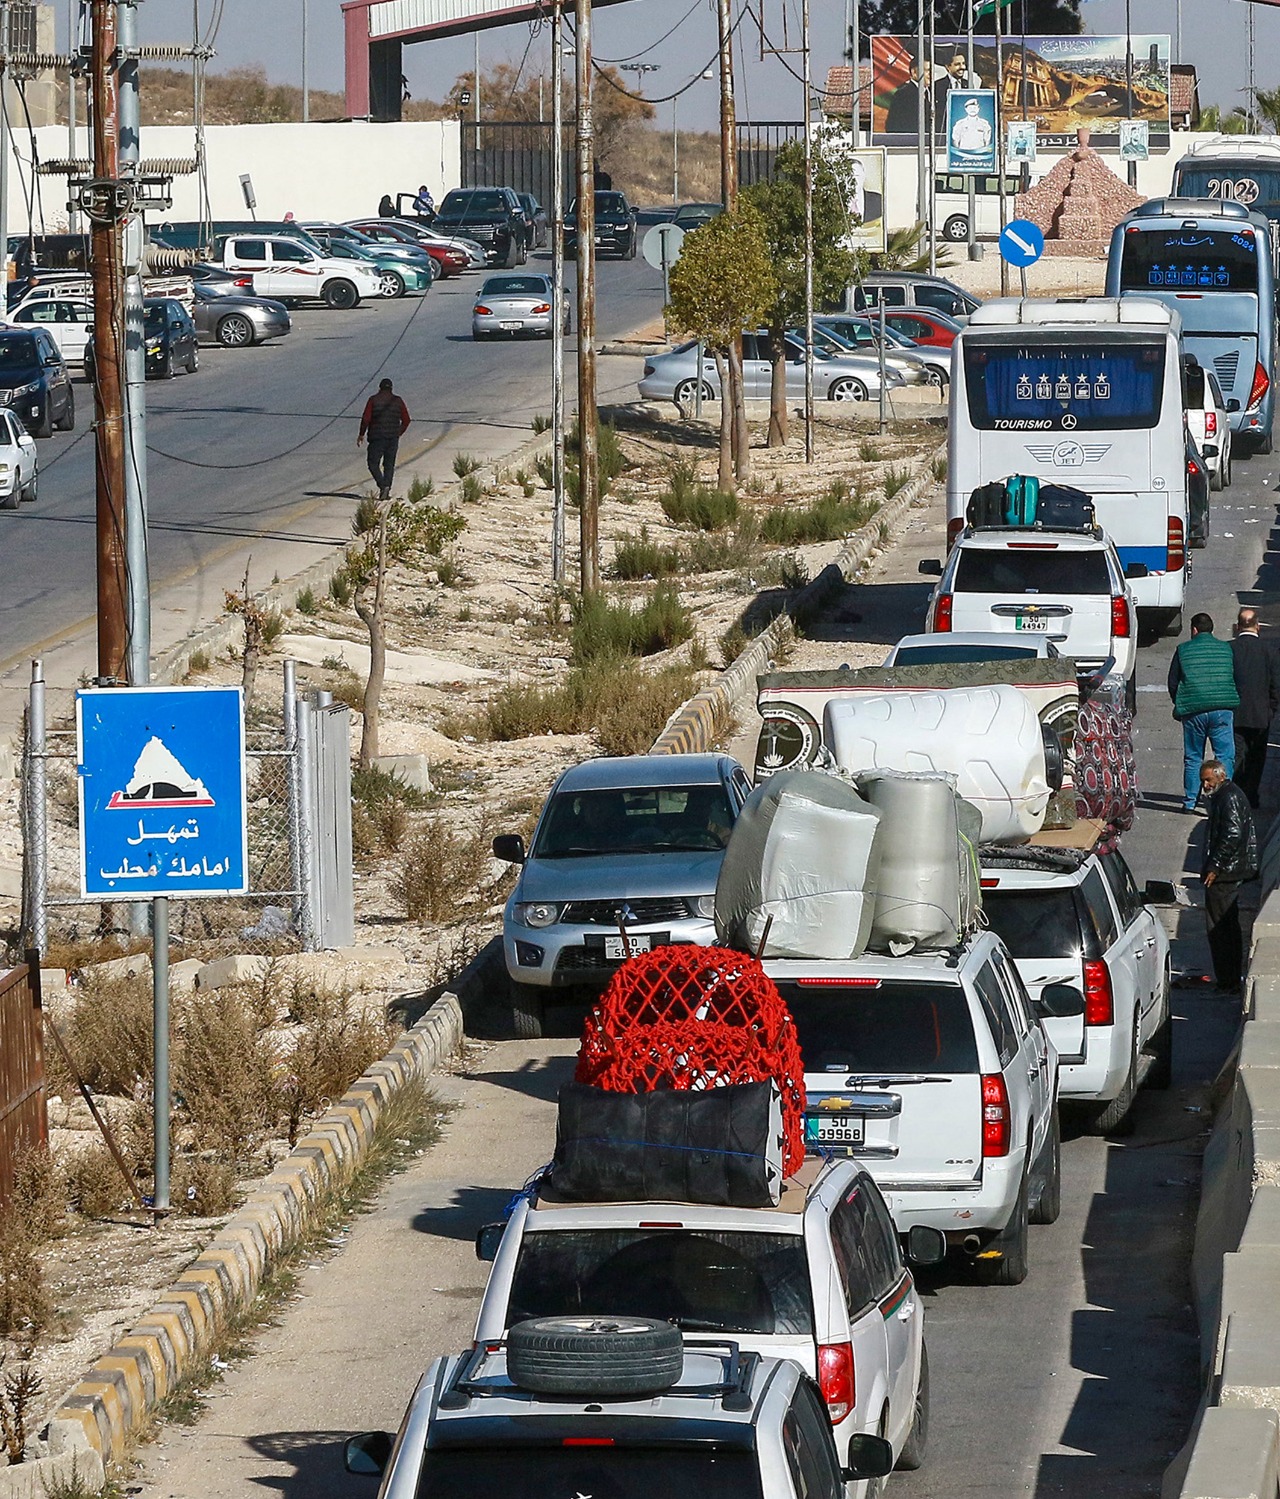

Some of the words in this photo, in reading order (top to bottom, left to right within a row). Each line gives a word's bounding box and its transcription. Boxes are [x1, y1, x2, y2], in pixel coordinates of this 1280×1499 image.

[1207, 178, 1258, 201] 2024
[1231, 234, 1255, 252] 2024
[994, 419, 1052, 429] TOURISMO
[127, 818, 199, 846] تمهل
[166, 856, 231, 877] امامك
[831, 1116, 848, 1128] 50
[818, 1129, 861, 1140] 39968
